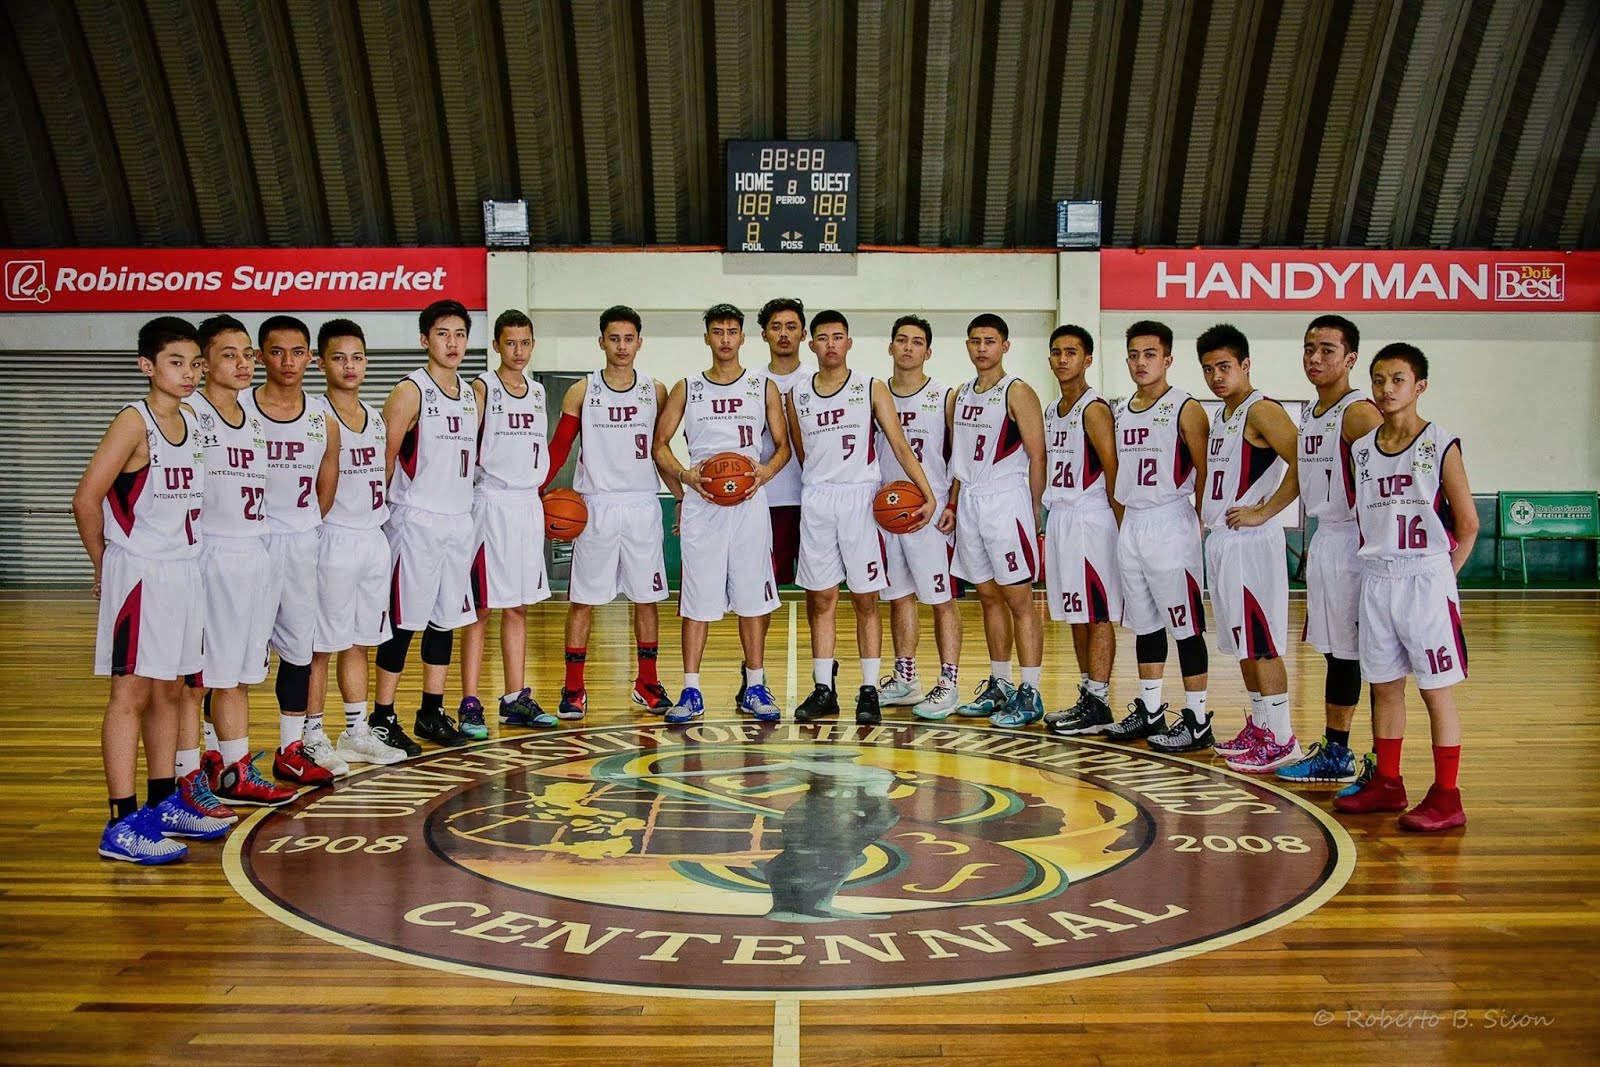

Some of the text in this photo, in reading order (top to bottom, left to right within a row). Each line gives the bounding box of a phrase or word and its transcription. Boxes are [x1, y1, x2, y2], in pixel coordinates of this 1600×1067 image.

[760, 148, 825, 170] 88:88
[735, 172, 774, 191] HOME
[787, 180, 797, 195] 8
[811, 172, 851, 192] GUEST
[738, 194, 771, 215] 188
[776, 196, 806, 204] PERIOD
[813, 194, 847, 216] 188
[747, 222, 760, 243] 8
[824, 222, 837, 243] 8
[742, 243, 764, 251] FOUL
[781, 241, 803, 249] POSS
[819, 243, 841, 252] FOUL
[55, 265, 447, 296] Robinsons Supermarket
[1157, 262, 1488, 300] HANDYMAN
[1521, 266, 1552, 279] Do it
[1497, 270, 1562, 298] Best
[608, 406, 638, 422] UP
[711, 398, 743, 413] UP
[962, 405, 984, 421] UP
[508, 413, 534, 429] UP
[816, 408, 844, 427] UP
[635, 434, 648, 459] 9
[738, 425, 753, 448] 11
[842, 434, 856, 460] 5
[1123, 428, 1149, 445] UP
[1211, 438, 1224, 455] UP
[1305, 435, 1323, 454] UP
[227, 447, 254, 469] UP
[266, 441, 304, 460] UP
[350, 447, 376, 466] UP
[911, 438, 924, 463] 3
[164, 468, 193, 490] UP
[1052, 461, 1074, 487] 26
[1138, 458, 1157, 486] 12
[297, 476, 313, 508] 2
[1212, 470, 1224, 500] 0
[1377, 474, 1412, 497] UP
[1397, 514, 1427, 550] 16
[867, 560, 878, 581] 5
[1005, 552, 1018, 572] 8
[652, 572, 663, 592] 9
[934, 574, 945, 592] 3
[1062, 592, 1082, 613] 26
[1168, 605, 1186, 628] 12
[1425, 646, 1453, 674] 16
[292, 724, 1282, 819] UNIVERSITY OF THE PHILIPPINES
[258, 836, 409, 855] 1908
[1167, 835, 1311, 854] 2008
[404, 898, 1190, 966] CENTENNIAL
